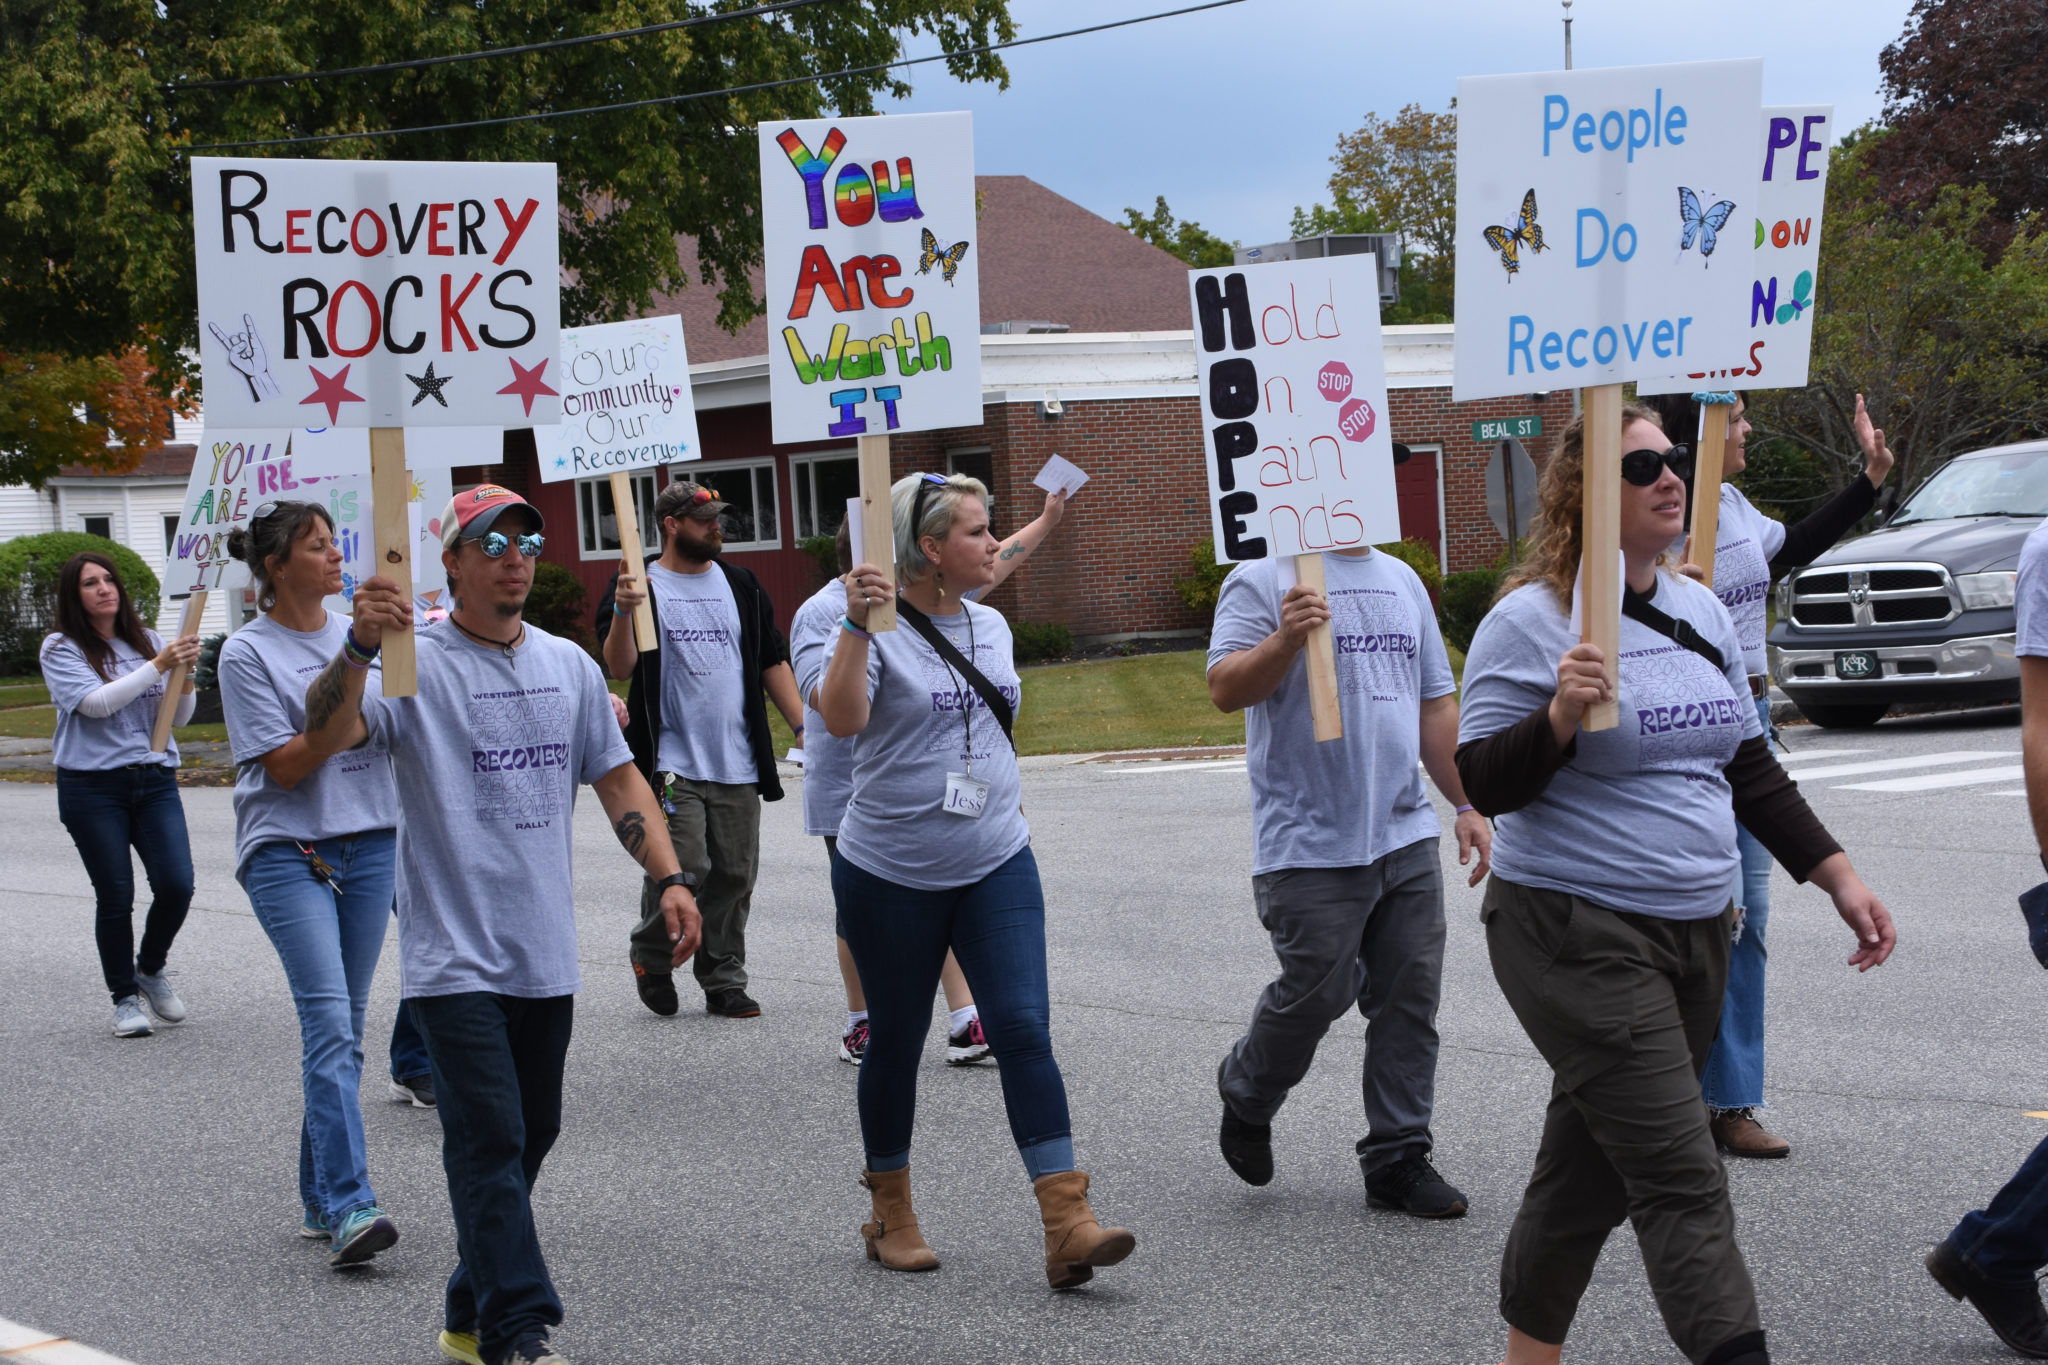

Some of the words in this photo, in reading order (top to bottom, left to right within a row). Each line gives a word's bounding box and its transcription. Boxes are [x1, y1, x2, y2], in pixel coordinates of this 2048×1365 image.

[1543, 88, 1687, 163] People
[1762, 115, 1826, 181] PE
[219, 170, 540, 266] RECOVERY
[1771, 217, 1812, 249] ON
[1575, 207, 1638, 268] Do
[787, 244, 914, 320] Are
[282, 269, 537, 360] ROCKS
[1194, 272, 1341, 353] Hold
[782, 311, 952, 385] Worth
[1507, 315, 1693, 376] Recover
[572, 342, 646, 386] Our
[561, 372, 673, 416] ommunity
[1209, 357, 1293, 420] On
[1320, 371, 1351, 393] STOP
[828, 384, 902, 437] IT
[1341, 403, 1370, 438] STOP
[586, 410, 650, 444] Our
[1481, 422, 1511, 439] BEAL
[1518, 420, 1532, 435] ST
[571, 442, 678, 474] Recovery
[1212, 420, 1347, 492] Pain
[191, 487, 248, 525] ARE
[330, 488, 359, 524] is
[1218, 490, 1364, 561] Ends
[178, 532, 224, 561] WOR
[189, 559, 230, 592] IT
[1328, 588, 1371, 596] WESTERN
[1372, 589, 1398, 597] MAINE
[1717, 580, 1769, 608] COVER
[666, 629, 729, 646] RECOVERY
[1335, 633, 1416, 660] RECOVERY
[1618, 646, 1672, 659] WESTERN
[296, 663, 329, 674] WESTER
[1841, 653, 1869, 672] K&R
[472, 690, 525, 700] WESTERN
[526, 686, 561, 695] MAINE
[931, 685, 1018, 712] RECOVRY
[1628, 676, 1737, 709] RECOVE
[341, 763, 371, 773] RALLY
[472, 743, 570, 773] RECOVERY
[960, 752, 991, 760] RALLY
[473, 768, 567, 797] RECOVE
[475, 792, 566, 822] RECOVE
[947, 788, 983, 812] Jess
[515, 820, 550, 830] RALLY
